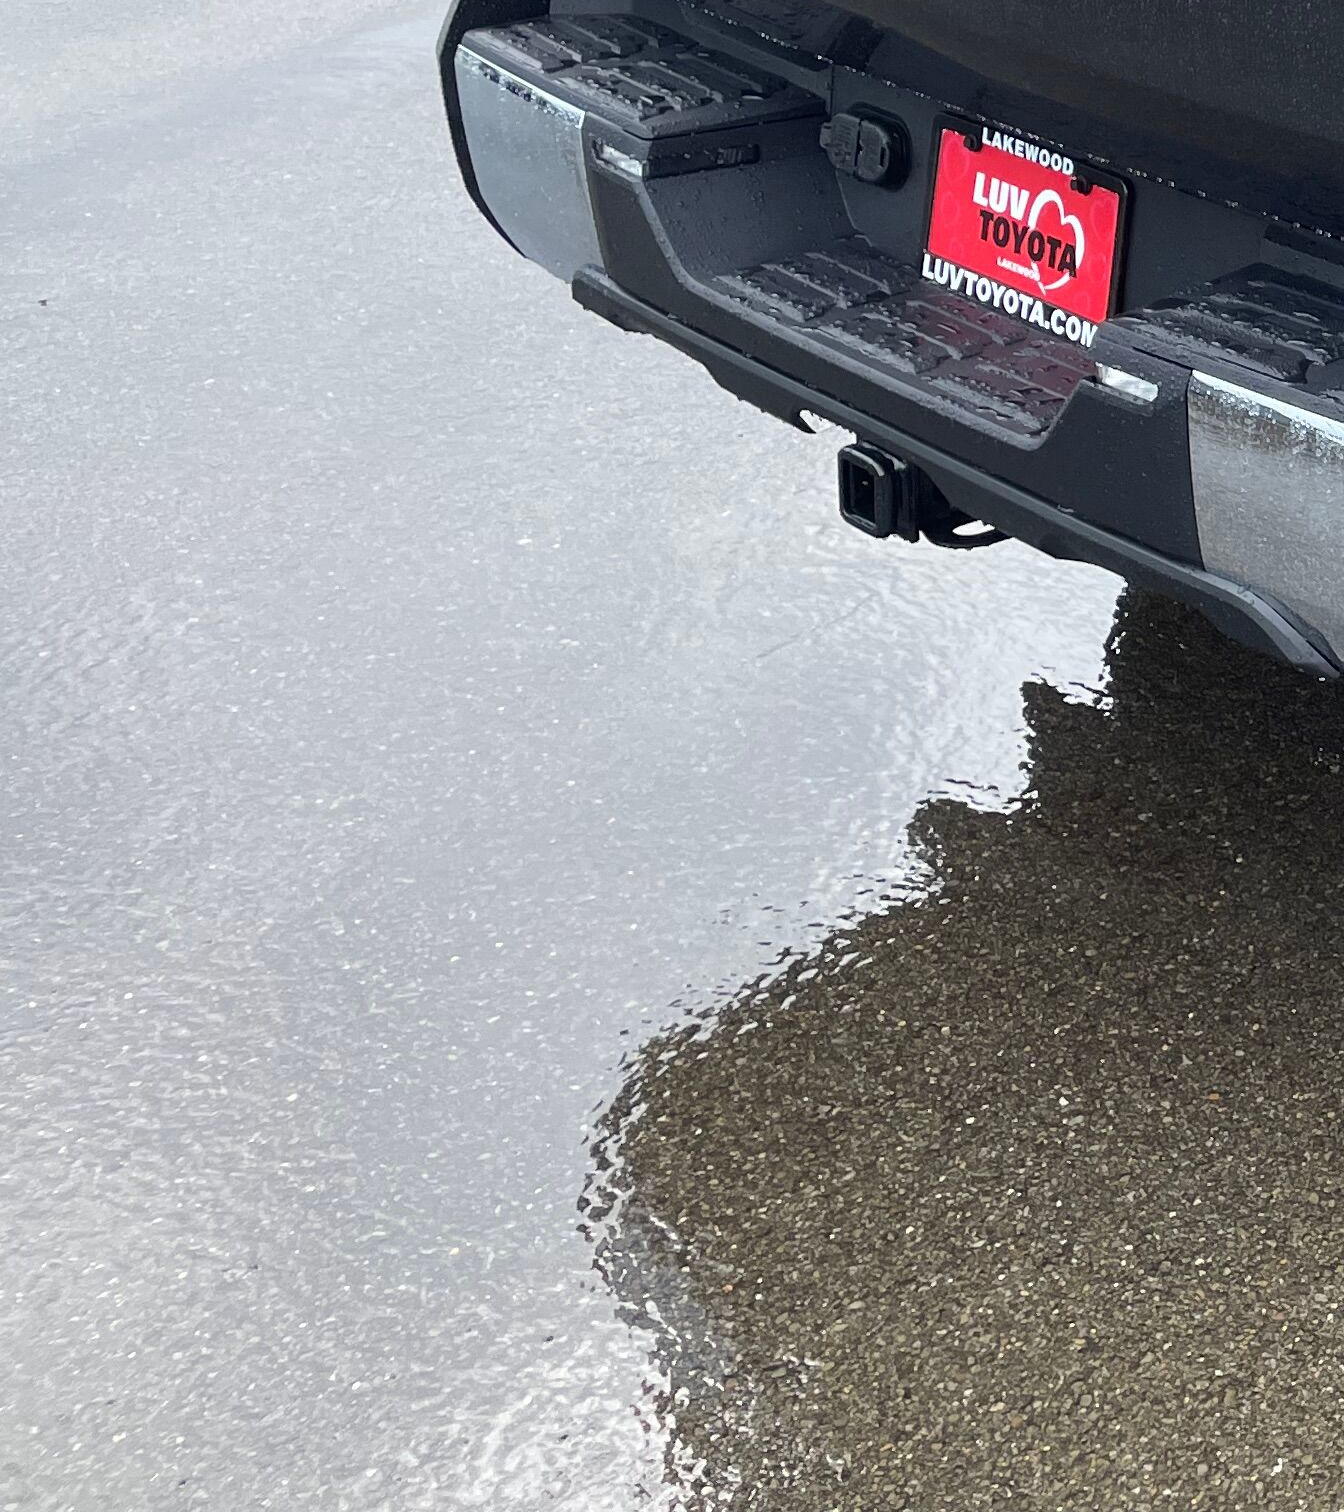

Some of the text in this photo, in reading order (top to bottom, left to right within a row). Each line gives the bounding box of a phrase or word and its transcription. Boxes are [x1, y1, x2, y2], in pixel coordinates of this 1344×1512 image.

[981, 126, 1076, 177] LAKEWOOD
[972, 171, 1030, 221] LUV
[979, 208, 1078, 278] TOYOTA
[921, 253, 1099, 349] LUVTOYOTA.COM
